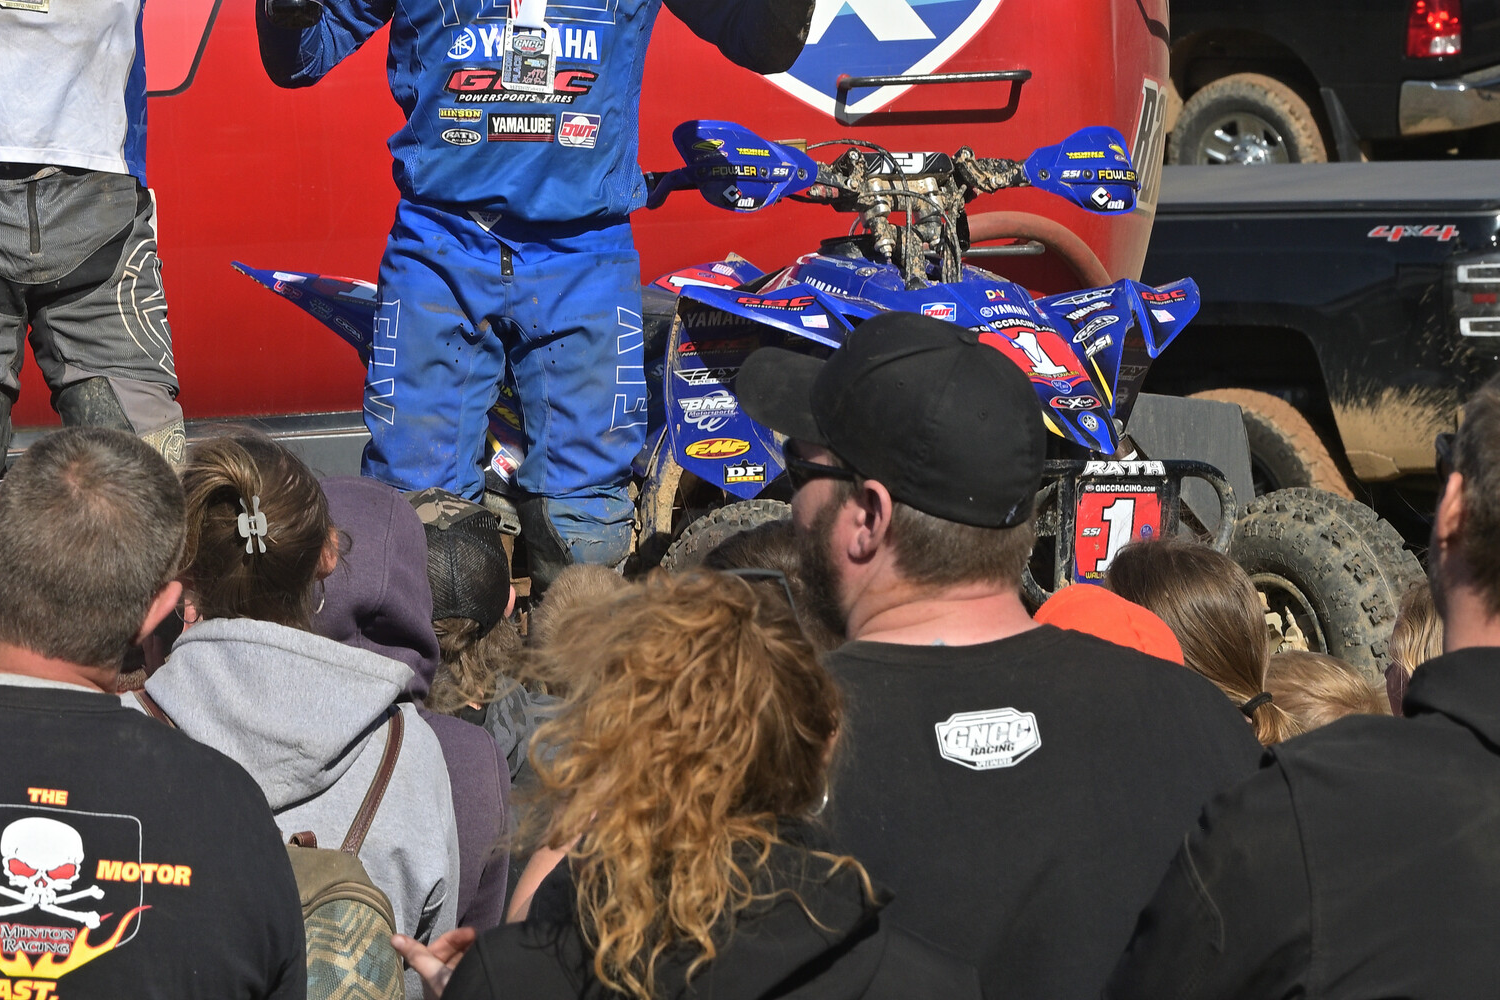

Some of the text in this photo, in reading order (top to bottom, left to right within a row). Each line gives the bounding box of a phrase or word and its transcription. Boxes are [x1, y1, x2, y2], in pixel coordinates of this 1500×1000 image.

[478, 27, 598, 61] YAHA
[445, 68, 598, 94] GC
[458, 93, 573, 104] POWERSPORTS TIRES
[440, 108, 482, 119] HINSON
[492, 116, 552, 134] YAMALUBE
[561, 123, 598, 138] DWT
[444, 130, 478, 140] RATH
[712, 166, 757, 176] FOWLER
[772, 167, 789, 177] SSI
[1060, 169, 1081, 179] SSI
[1098, 169, 1136, 181] FOWLER
[736, 296, 818, 308] GBC
[1141, 289, 1187, 302] GBC
[924, 307, 954, 317] DWT
[991, 304, 1030, 317] YAMAHA
[1009, 331, 1070, 375] 1
[1085, 334, 1114, 358] SSI
[686, 396, 737, 410] BNR
[688, 409, 734, 417] Motorsports
[686, 440, 750, 456] FMF
[726, 466, 764, 477] DP
[1081, 460, 1167, 476] RATH
[1095, 484, 1156, 493] GNCCRACING.COM
[1081, 527, 1102, 537] SSI
[1095, 497, 1137, 572] 1
[945, 718, 1032, 750] GNCC
[970, 743, 1015, 757] RACING
[27, 786, 69, 806] THE
[95, 859, 192, 887] MOTOR
[0, 922, 78, 942] MINTON
[1, 937, 71, 957] RACING
